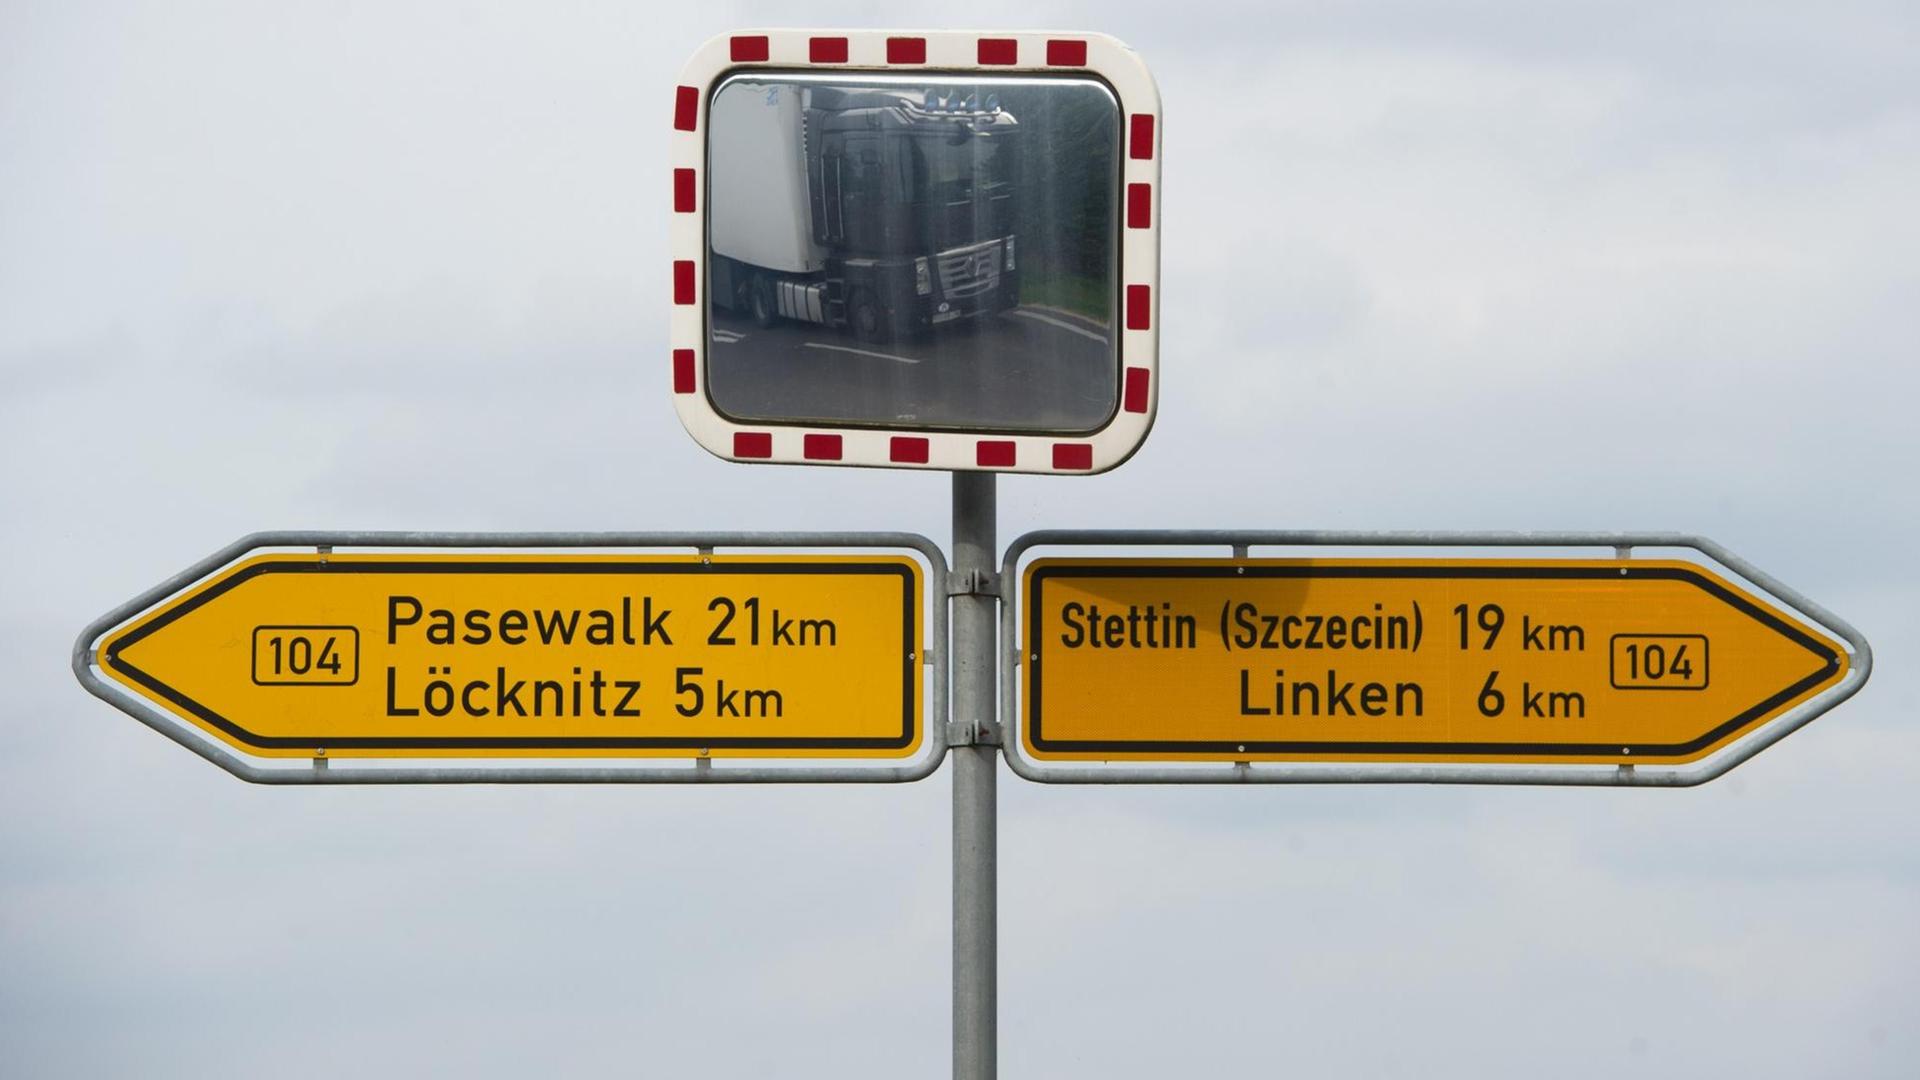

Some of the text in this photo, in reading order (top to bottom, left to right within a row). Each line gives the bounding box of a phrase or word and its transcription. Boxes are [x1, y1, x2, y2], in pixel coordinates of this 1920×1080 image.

[387, 595, 673, 646] Pasewalk
[1061, 596, 1585, 653] Stettin (Szczecin) 19 km
[269, 636, 342, 675] 104
[1626, 644, 1693, 680] 104
[386, 666, 641, 718] Löcknitz
[1240, 669, 1585, 719] Linken 6 km
